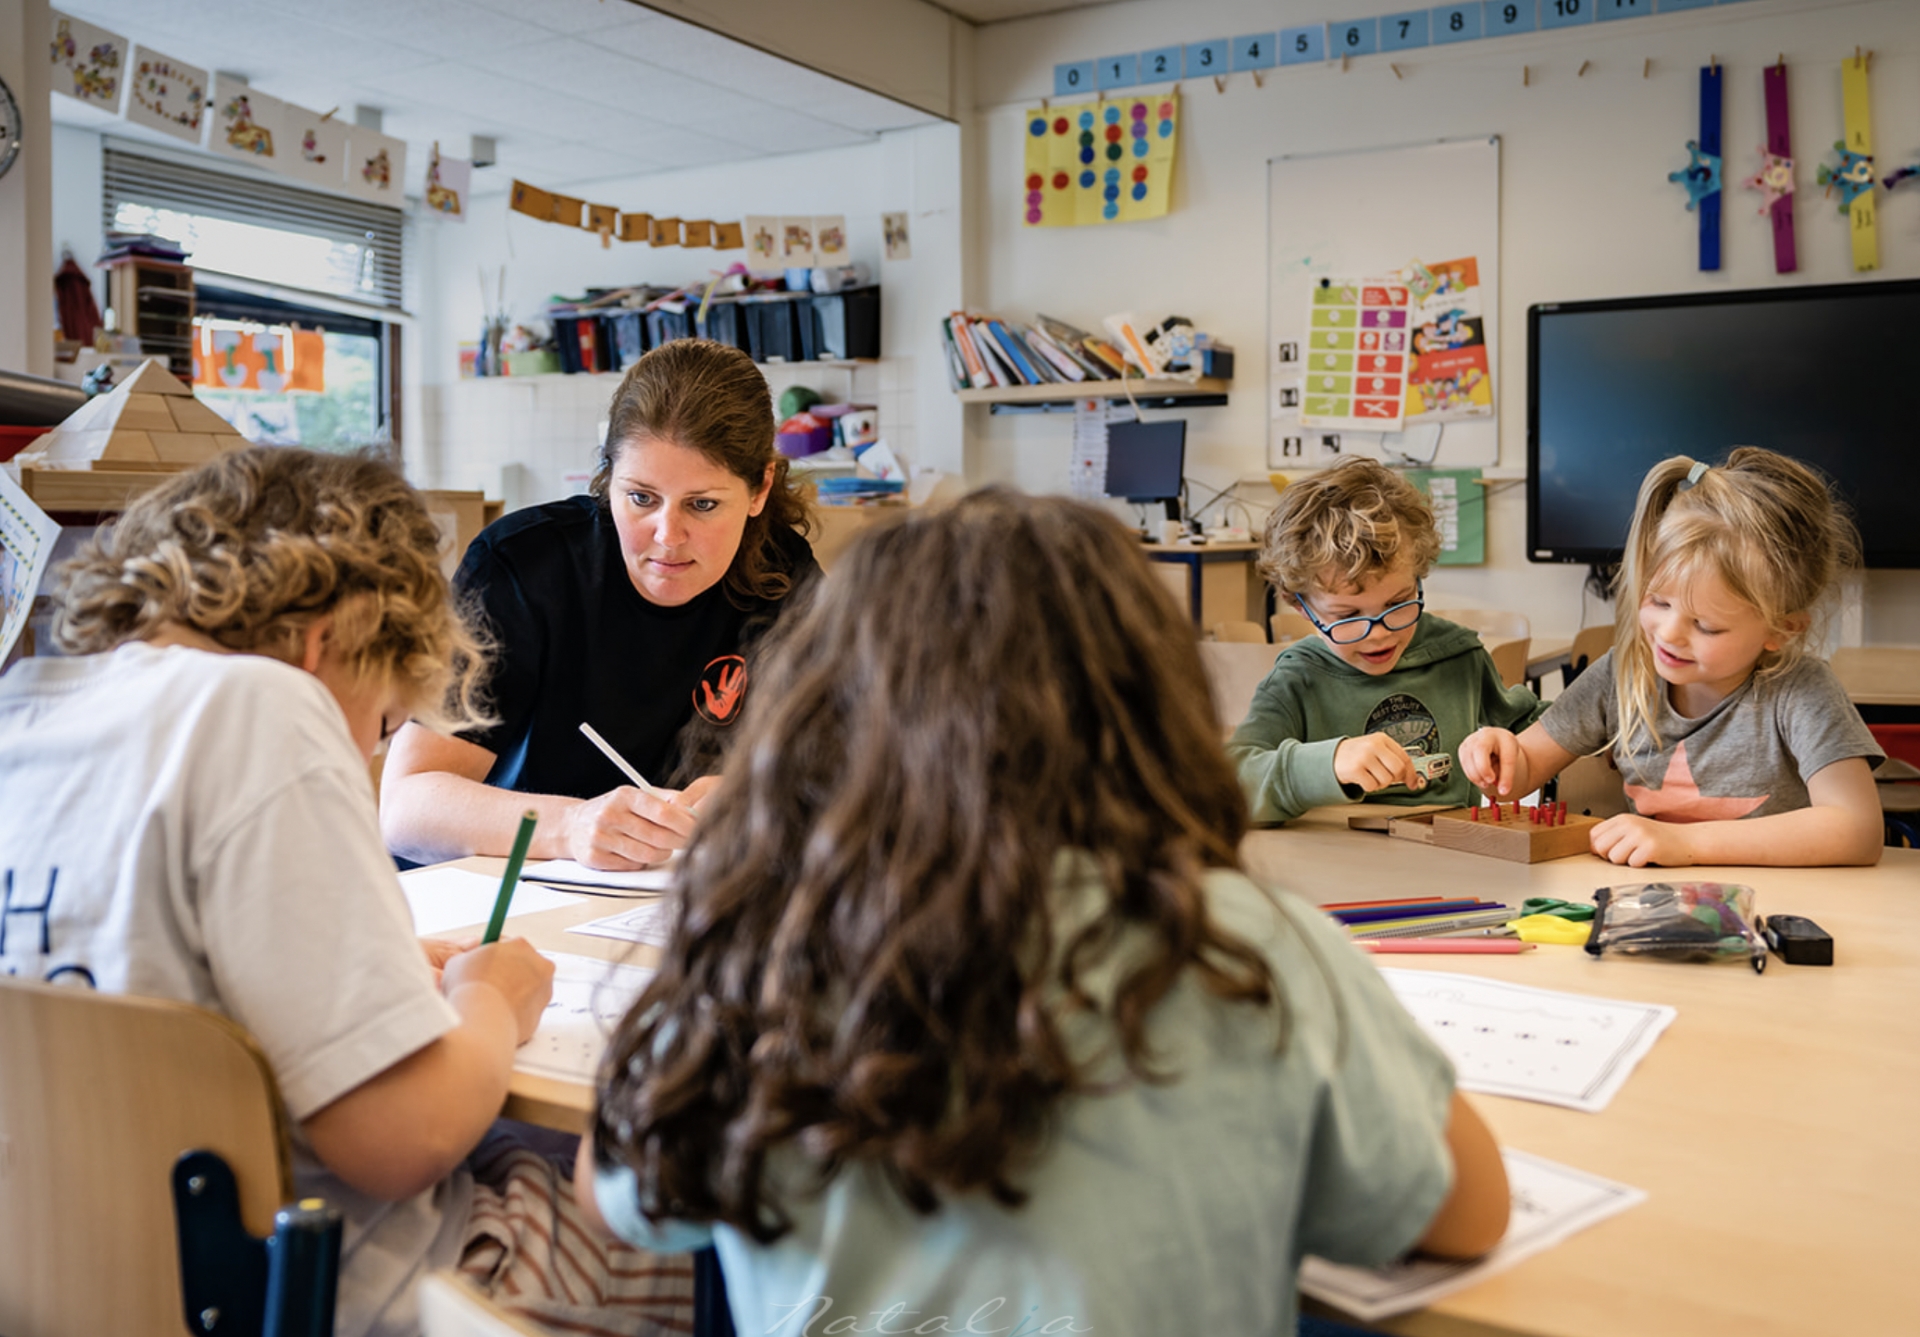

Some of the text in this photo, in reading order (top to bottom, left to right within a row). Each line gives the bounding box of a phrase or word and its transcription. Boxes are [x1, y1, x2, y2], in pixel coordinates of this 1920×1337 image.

[1067, 0, 1580, 86] 0 1 2 3 4 5 6 7 8 9 10
[1391, 702, 1421, 712] QUALITY
